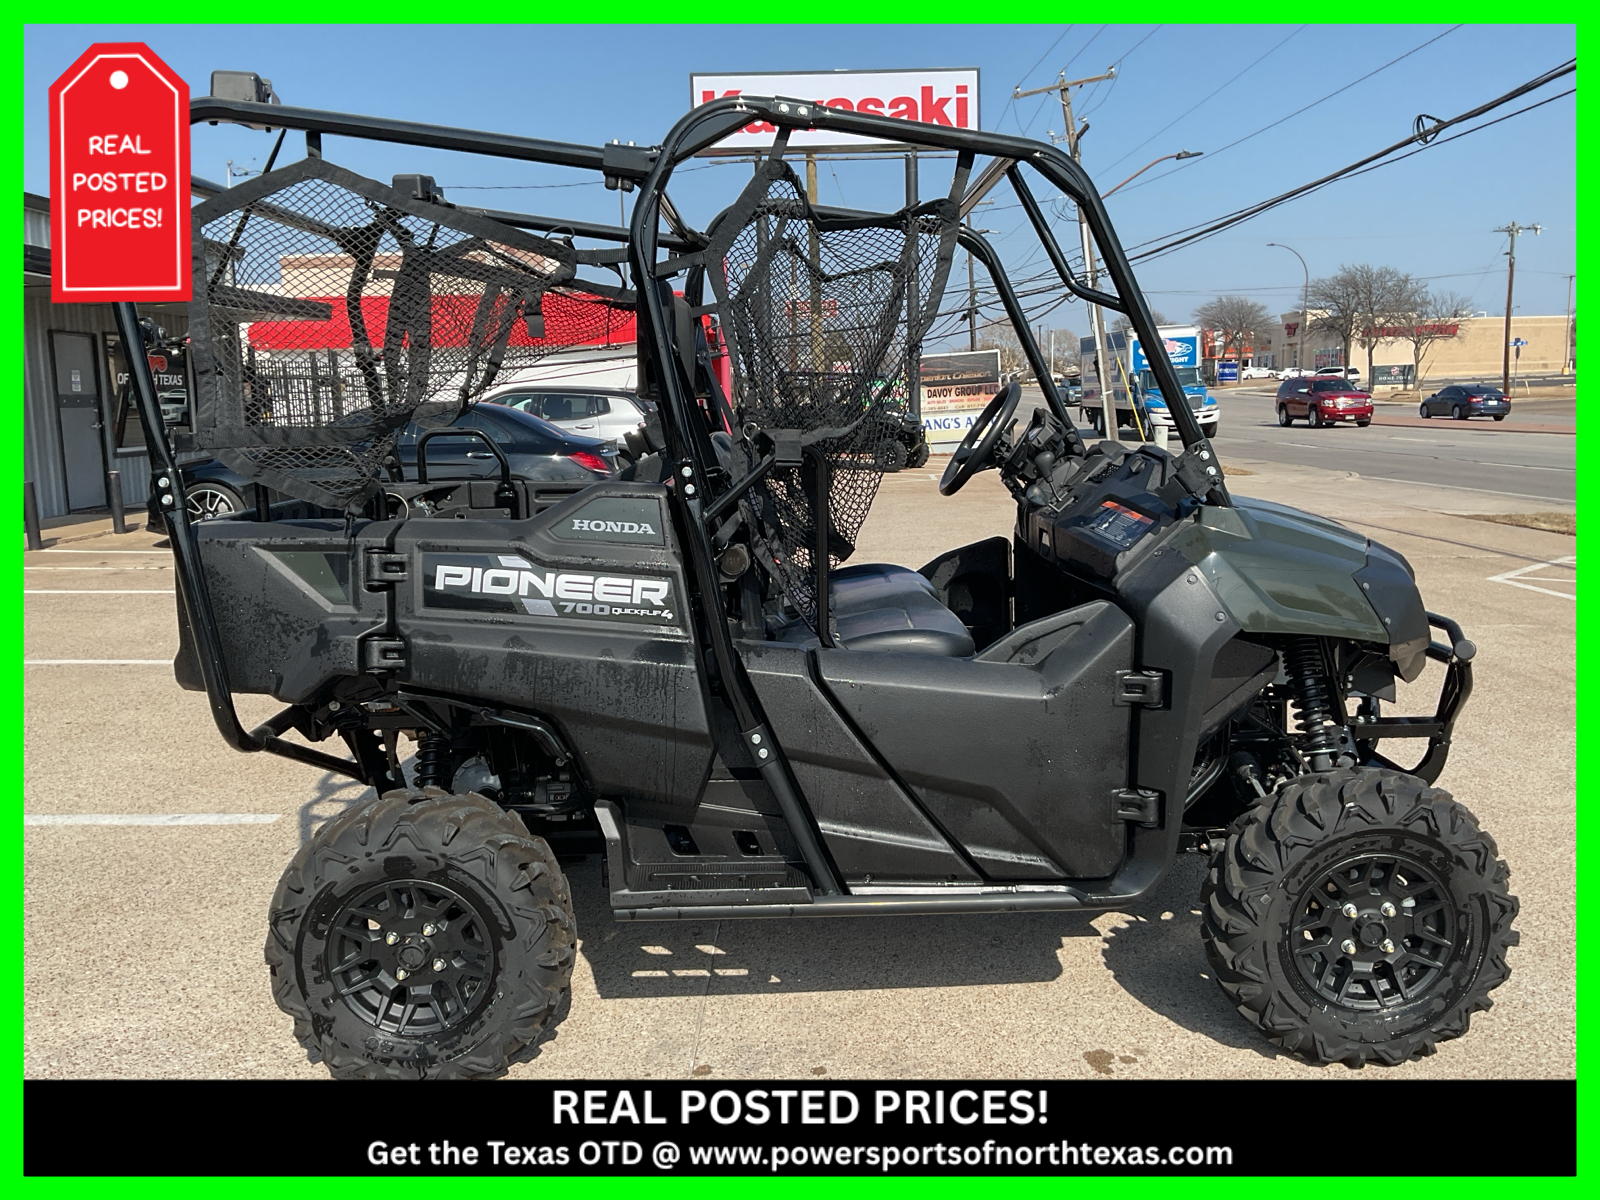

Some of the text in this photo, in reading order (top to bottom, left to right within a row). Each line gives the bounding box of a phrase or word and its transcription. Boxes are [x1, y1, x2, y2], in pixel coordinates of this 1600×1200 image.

[159, 374, 183, 385] TEXAS
[928, 383, 999, 398] DAVOY GROUP LLC
[925, 417, 960, 430] ANG'S
[572, 519, 656, 535] HONDA
[435, 564, 669, 606] PIONEER
[558, 601, 611, 615] 700
